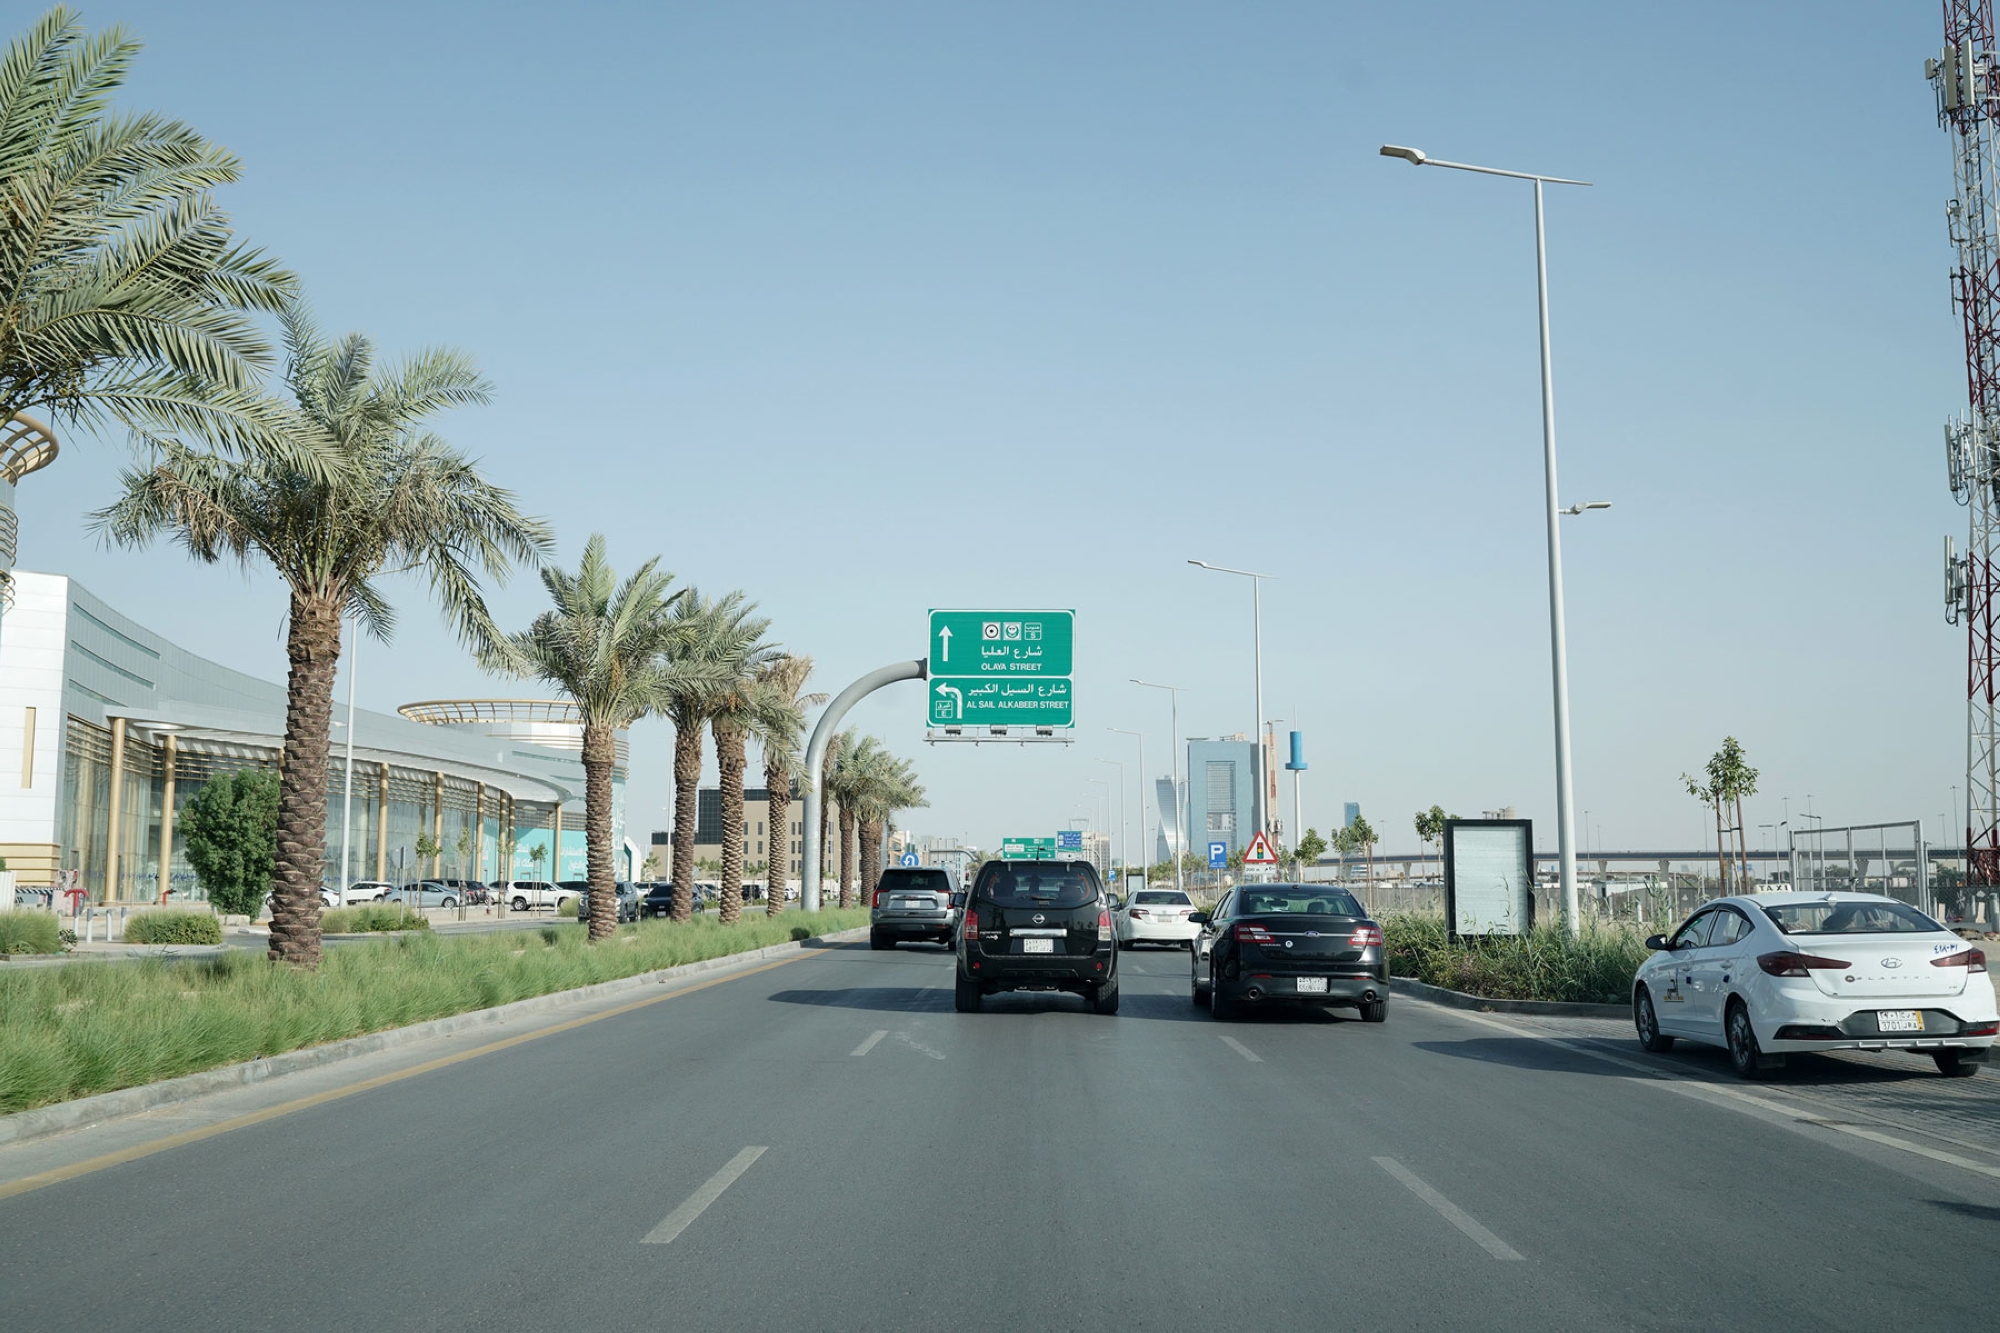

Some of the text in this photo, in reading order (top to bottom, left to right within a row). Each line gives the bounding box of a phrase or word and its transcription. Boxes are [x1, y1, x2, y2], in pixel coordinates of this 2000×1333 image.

[981, 645, 1043, 659] شارع العليا
[981, 663, 1042, 671] OLAYA STREET
[968, 683, 1067, 697] شارع السيل الكبير
[966, 701, 1069, 709] AL SAIL ALKABEER STREET
[1210, 844, 1224, 861] P
